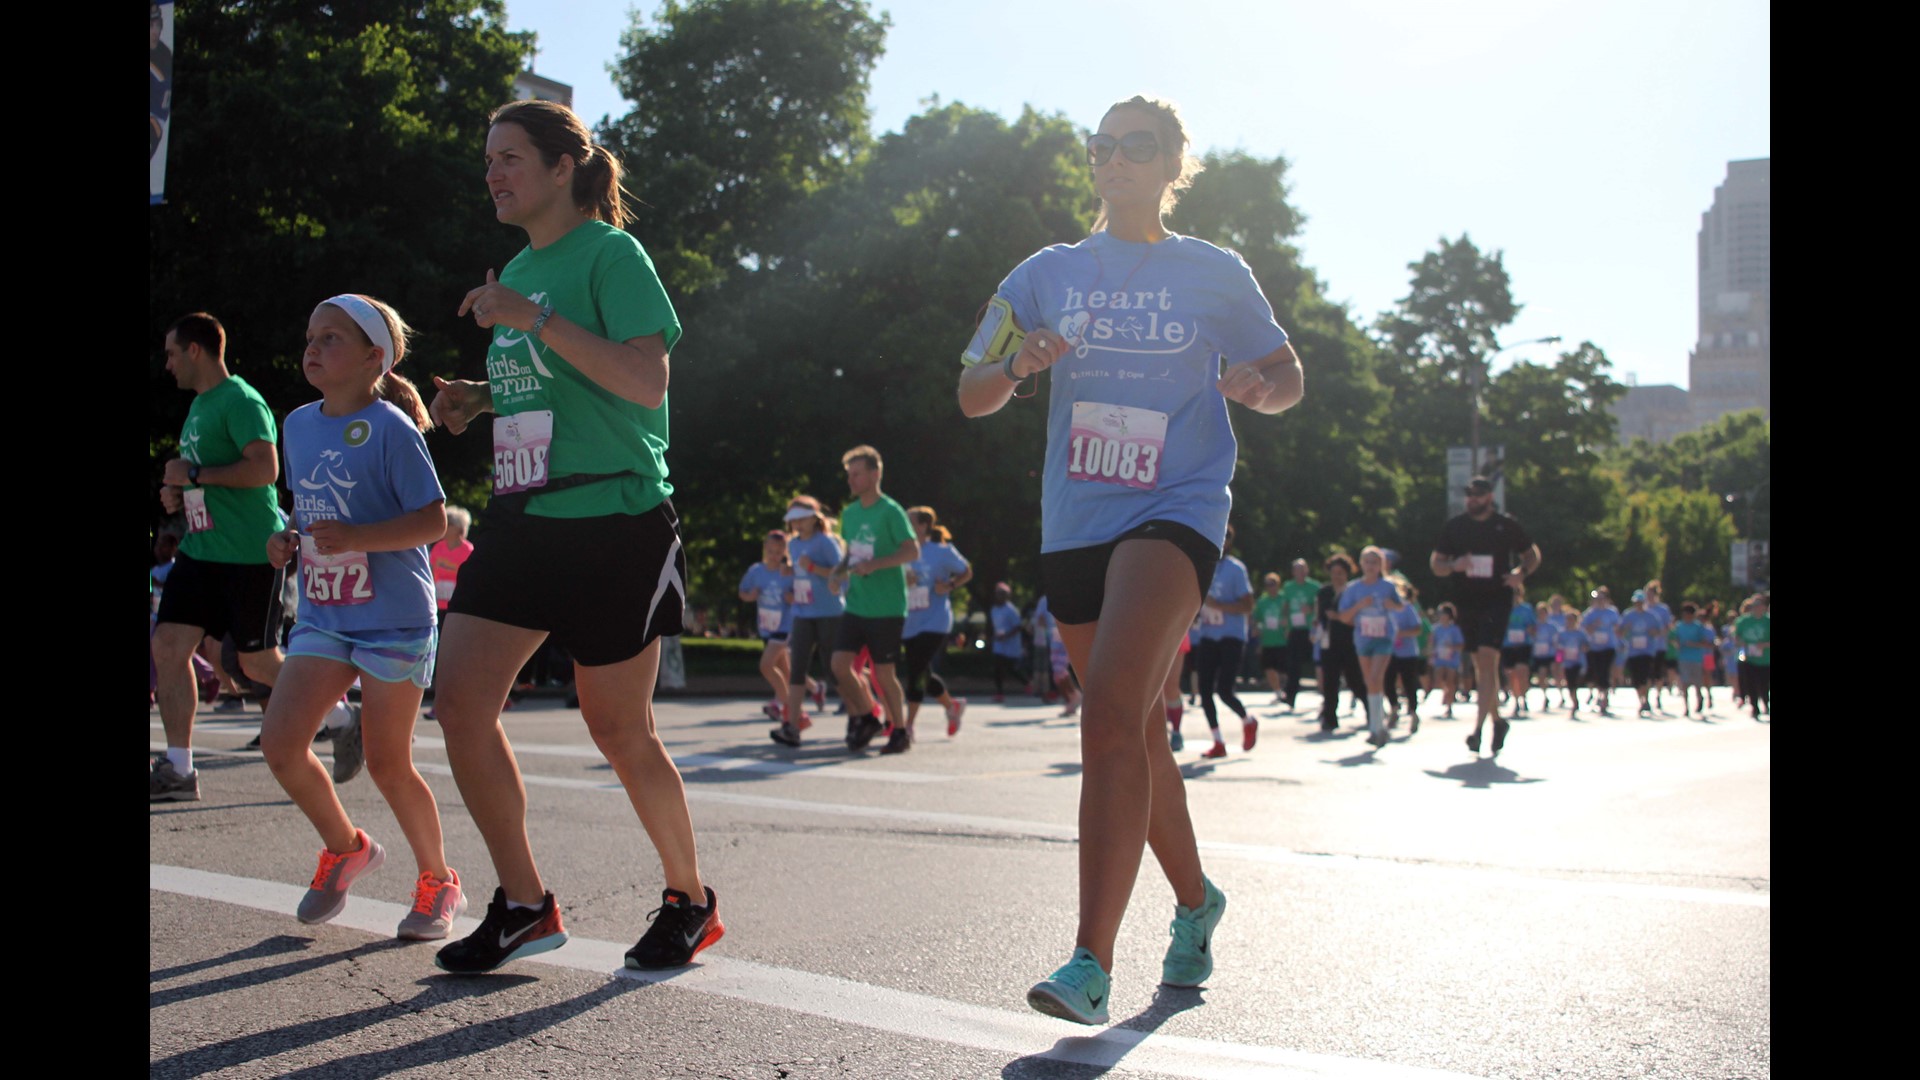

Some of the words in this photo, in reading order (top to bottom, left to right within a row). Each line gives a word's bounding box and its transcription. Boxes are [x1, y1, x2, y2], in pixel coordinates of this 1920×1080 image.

[1061, 286, 1172, 311] heart
[520, 365, 532, 375] on
[490, 383, 502, 394] he
[502, 375, 543, 396] run
[495, 445, 548, 490] 5608
[1069, 436, 1159, 483] 10083
[295, 493, 326, 512] Girls
[303, 563, 372, 602] 2572
